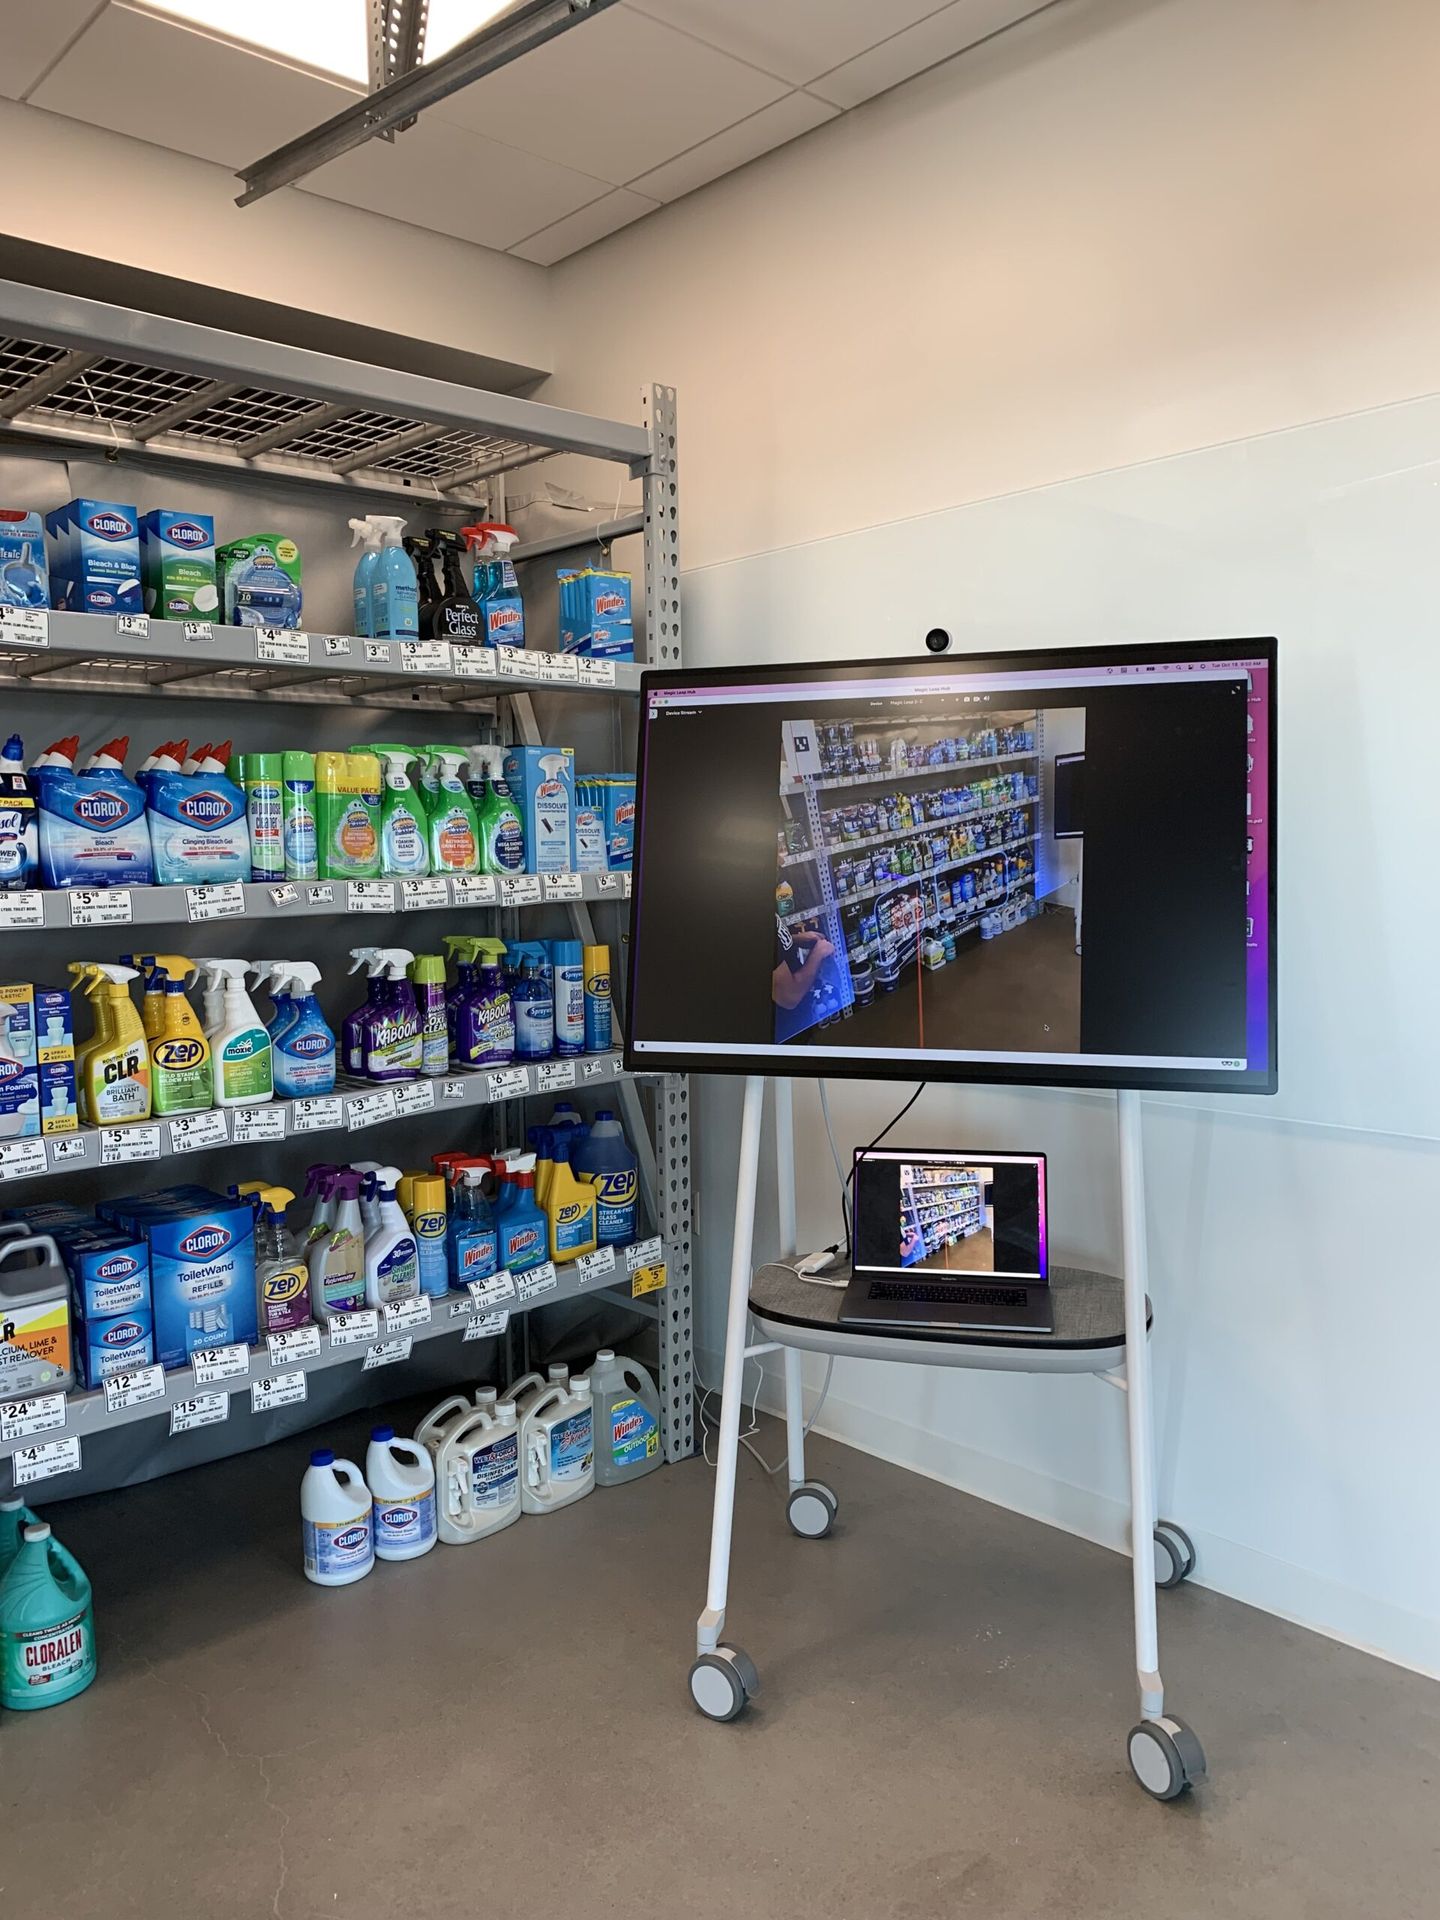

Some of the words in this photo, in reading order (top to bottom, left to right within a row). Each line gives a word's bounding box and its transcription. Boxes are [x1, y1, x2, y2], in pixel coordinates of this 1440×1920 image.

[93, 519, 127, 533] CLOROX
[171, 528, 204, 542] CLOROX
[88, 559, 113, 568] Bleach
[121, 563, 137, 571] Blue
[178, 568, 201, 576] Bleach
[90, 594, 112, 603] CLOROX
[242, 593, 251, 601] 10
[169, 603, 190, 611] CLOROX
[596, 596, 624, 615] Windex
[445, 608, 479, 624] Perfect
[489, 611, 522, 631] Windex
[448, 622, 477, 636] Glass
[337, 786, 360, 794] VALUE
[361, 787, 379, 795] PACK
[80, 802, 122, 817] CLOROX
[186, 802, 227, 816] CLOROX
[429, 1016, 445, 1024] OXI
[478, 1001, 511, 1026] KABOOM
[376, 1019, 418, 1047] KABOOM
[423, 1023, 448, 1034] CLEAN
[227, 1046, 252, 1055] moxie
[296, 1040, 327, 1051] CLOROX
[104, 1056, 139, 1084] CLR
[5, 1083, 33, 1091] Foamer
[106, 1086, 139, 1096] BRILLIANT
[112, 1093, 135, 1102] BATH
[48, 1122, 54, 1130] 2
[186, 1232, 225, 1252] CLOROX
[509, 1231, 538, 1255] Windex
[464, 1244, 494, 1269] Windex
[101, 1261, 133, 1276] CLOROX
[176, 1261, 234, 1284] ToiletWand
[95, 1280, 140, 1298] ToiletWand
[192, 1280, 223, 1293] REFILLS
[110, 1296, 131, 1306] Starter
[0, 1322, 15, 1344] R
[107, 1326, 138, 1342] CLOROX
[194, 1337, 202, 1345] 20
[204, 1332, 227, 1342] COUNT
[0, 1344, 28, 1357] CIUM,
[29, 1337, 49, 1350] LIME
[50, 1336, 57, 1344] &
[10, 1346, 54, 1363] REMOVER
[100, 1346, 146, 1364] ToiletWand
[115, 1363, 136, 1372] Starter
[613, 1416, 644, 1442] Windex
[476, 1462, 517, 1479] DISINFECTANT
[384, 1512, 414, 1523] CLOROX
[338, 1531, 366, 1547] CLOROX
[26, 1628, 82, 1668] CLORALEN
[42, 1657, 71, 1672] BLEACH
